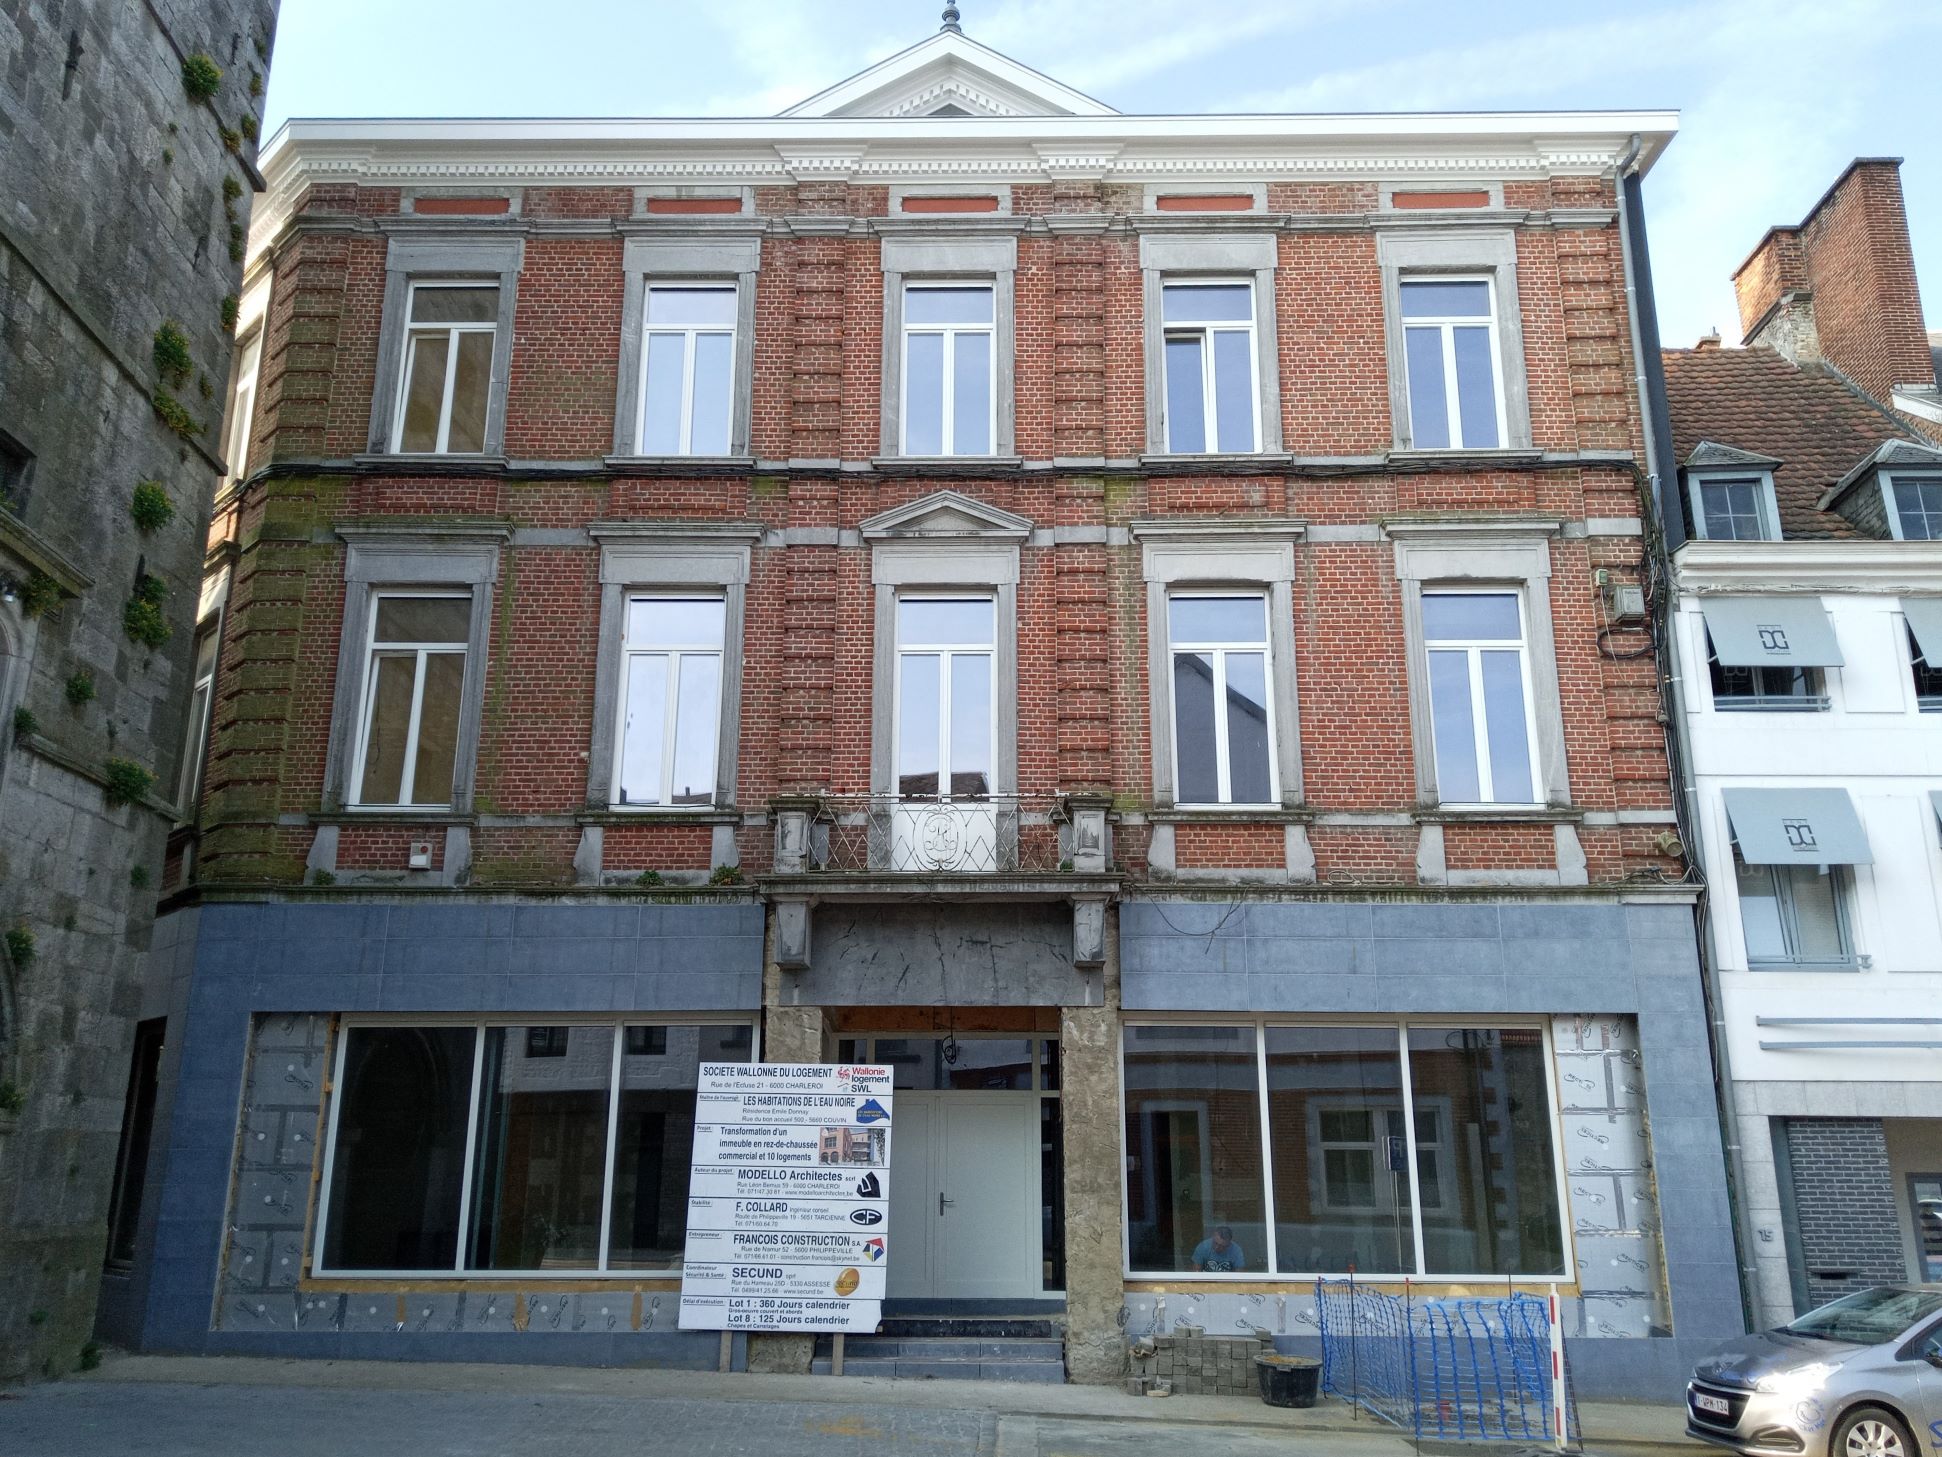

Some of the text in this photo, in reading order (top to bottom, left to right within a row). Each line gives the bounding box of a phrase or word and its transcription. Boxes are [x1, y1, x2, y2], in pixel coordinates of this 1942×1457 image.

[703, 1066, 832, 1078] SOCIETE WALLONNE DU LOGEMENT
[852, 1067, 885, 1076] Wallonie
[851, 1075, 890, 1084] logement
[851, 1084, 872, 1093] SWL
[743, 1096, 856, 1107] LES HABITATIONS DE L'EAU NOIRE
[721, 1127, 787, 1136] Transformation d'un
[719, 1139, 752, 1148] immeuble
[763, 1140, 818, 1149] rez-de-chaussée
[718, 1152, 758, 1160] commercial
[767, 1152, 775, 1160] 10
[776, 1152, 812, 1162] logements
[738, 1169, 787, 1180] MODELLO
[790, 1170, 843, 1181] Architectes
[736, 1202, 744, 1212] F.
[745, 1202, 788, 1212] COLLARD
[733, 1234, 779, 1245] FRANCOIS
[780, 1235, 850, 1246] CONSTRUCTION
[732, 1267, 783, 1279] SECUND
[729, 1299, 743, 1308] Lot
[747, 1299, 750, 1308] 1
[759, 1299, 775, 1308] 360
[777, 1300, 803, 1309] Jours
[805, 1300, 850, 1310] calendrier
[727, 1314, 742, 1322] Lot
[745, 1314, 750, 1323] 8
[759, 1314, 774, 1323] 125
[776, 1315, 802, 1324] Jours
[804, 1315, 850, 1325] calendrier
